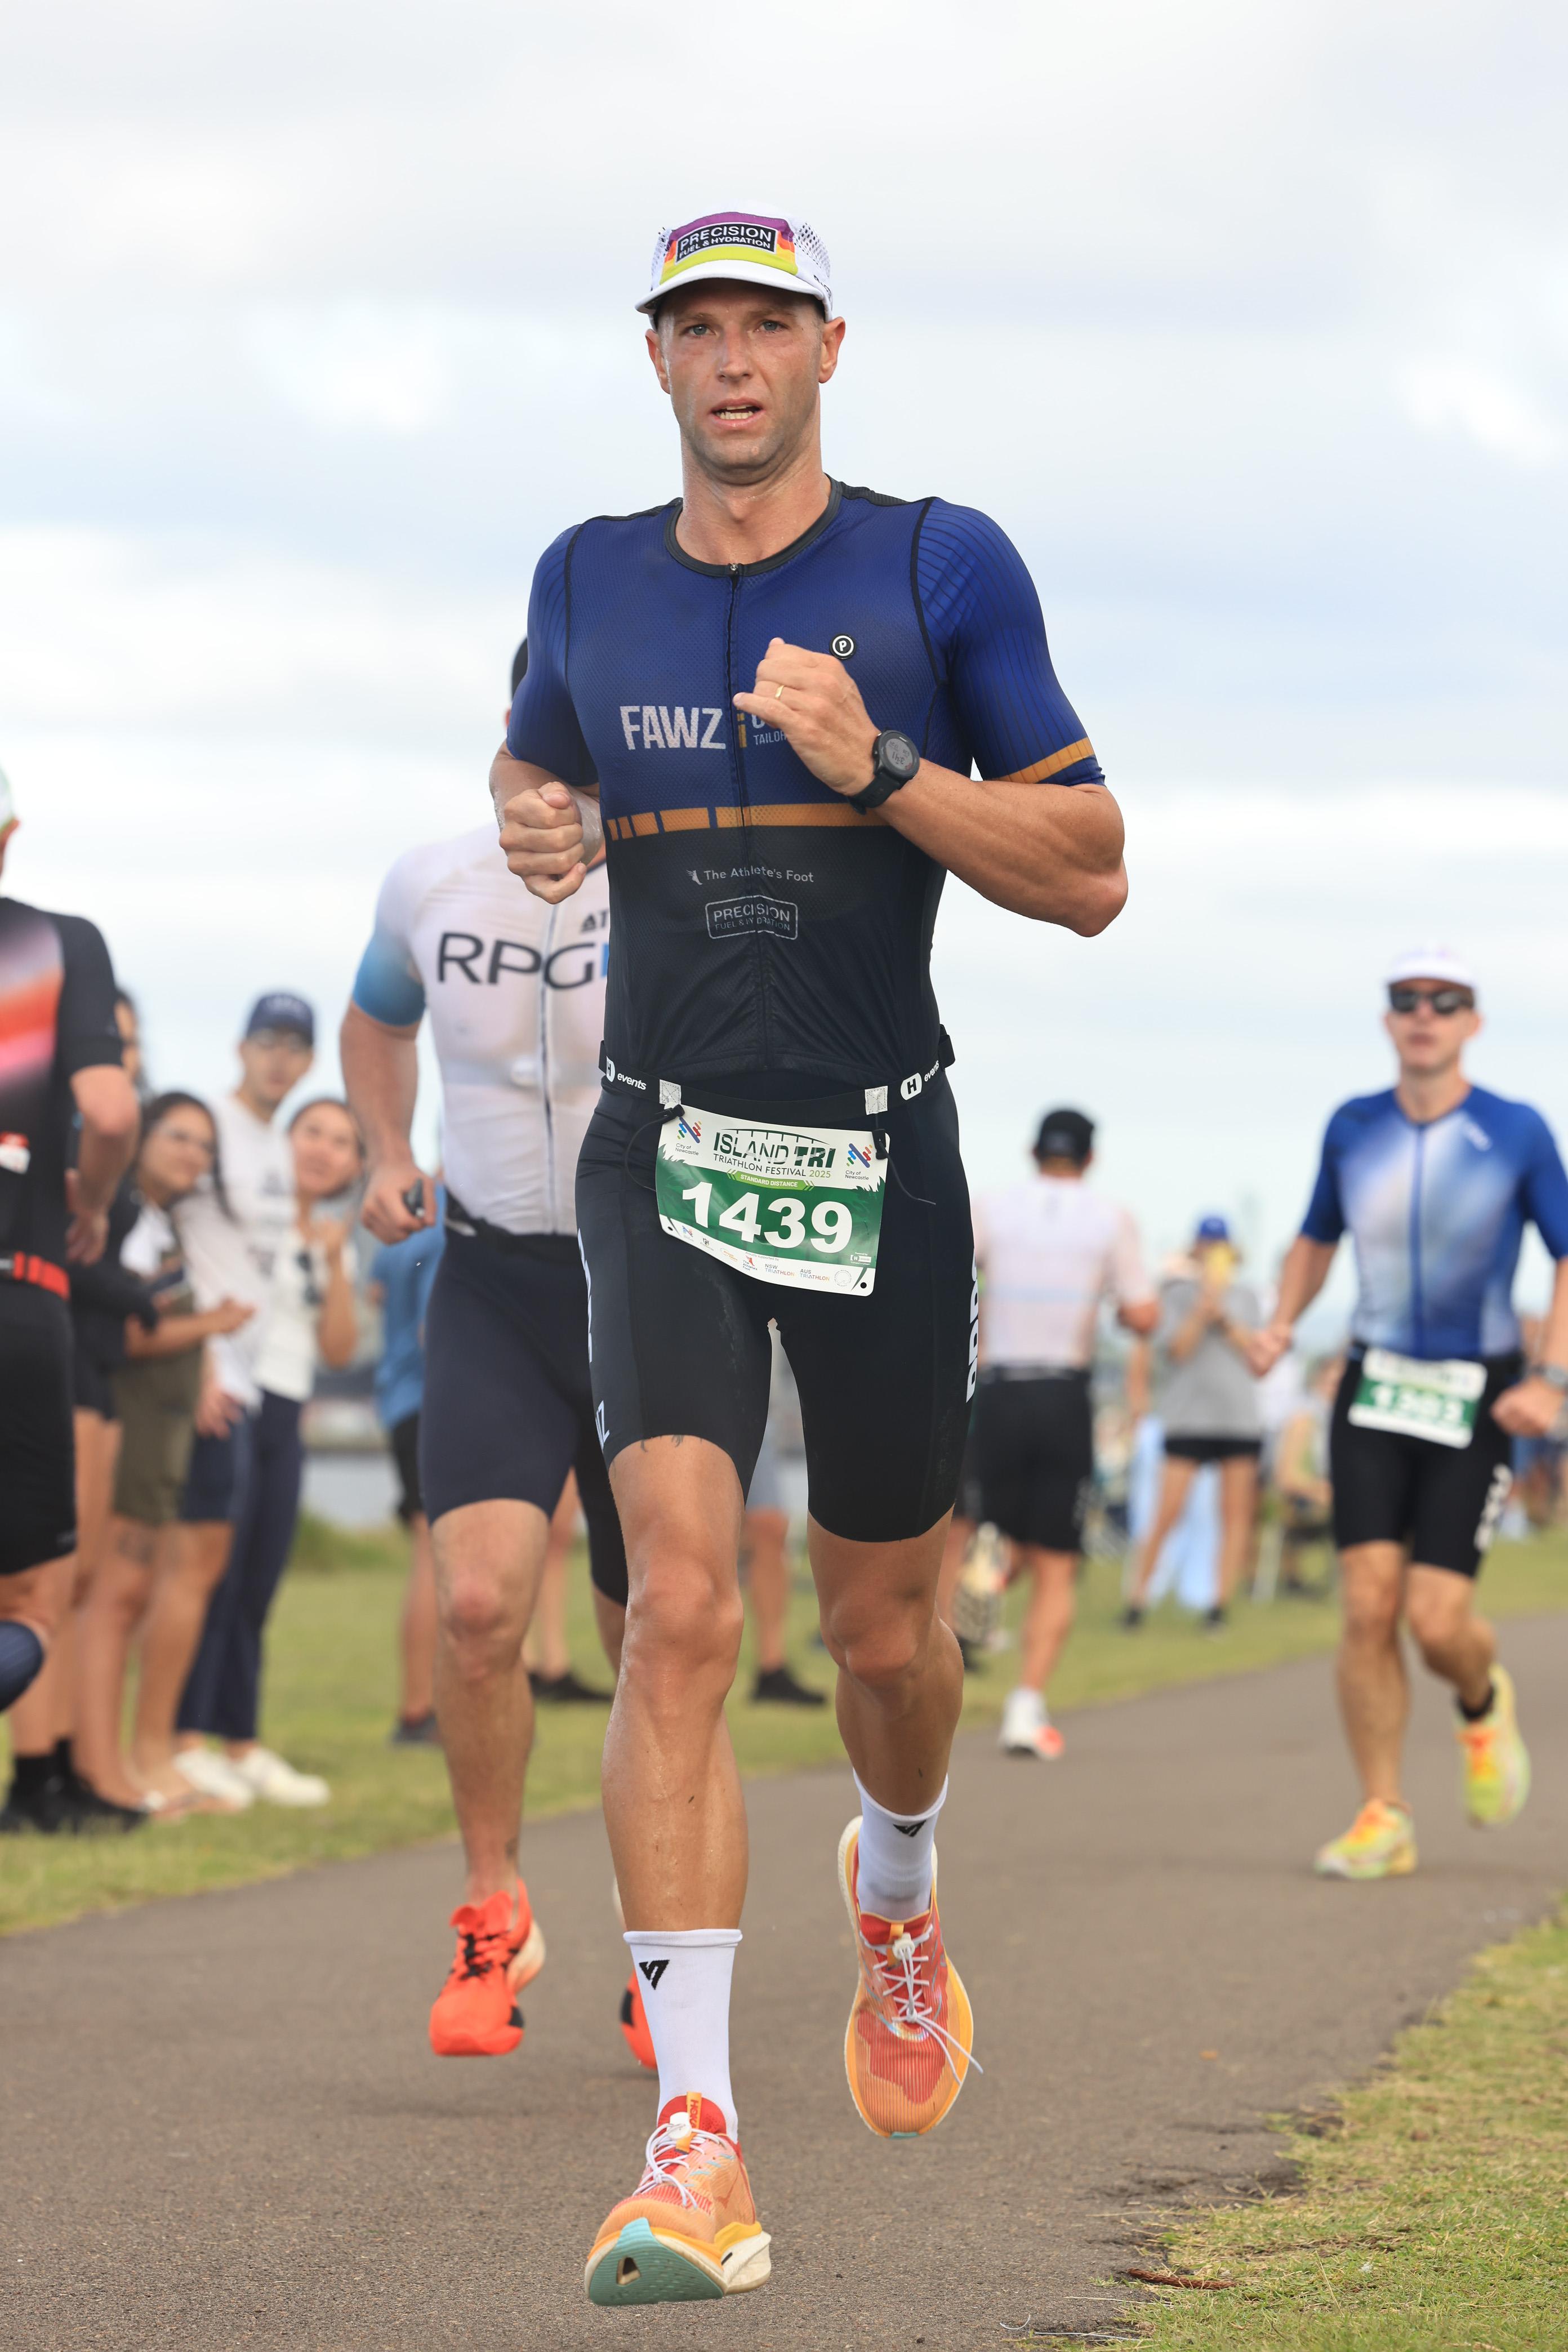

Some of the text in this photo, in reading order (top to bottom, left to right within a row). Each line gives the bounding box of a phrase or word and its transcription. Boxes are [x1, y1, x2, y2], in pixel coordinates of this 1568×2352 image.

[679, 245, 701, 259] FUEL
[711, 237, 770, 249] HYDRATION
[680, 226, 772, 251] PRECISION
[620, 705, 726, 750] FAWZ
[704, 865, 814, 883] The Athlete's Foot
[714, 903, 790, 922] PRECISION
[715, 921, 737, 930] FUEL
[617, 1073, 647, 1090] events
[924, 1060, 939, 1082] events
[713, 1132, 836, 1168] ISLAND TRI
[713, 1153, 831, 1178] TRIATHLON FESTIVAL 2025
[740, 1174, 769, 1185] STANDARD
[682, 1181, 853, 1253] 1439
[765, 1268, 795, 1277] TRIATHLON
